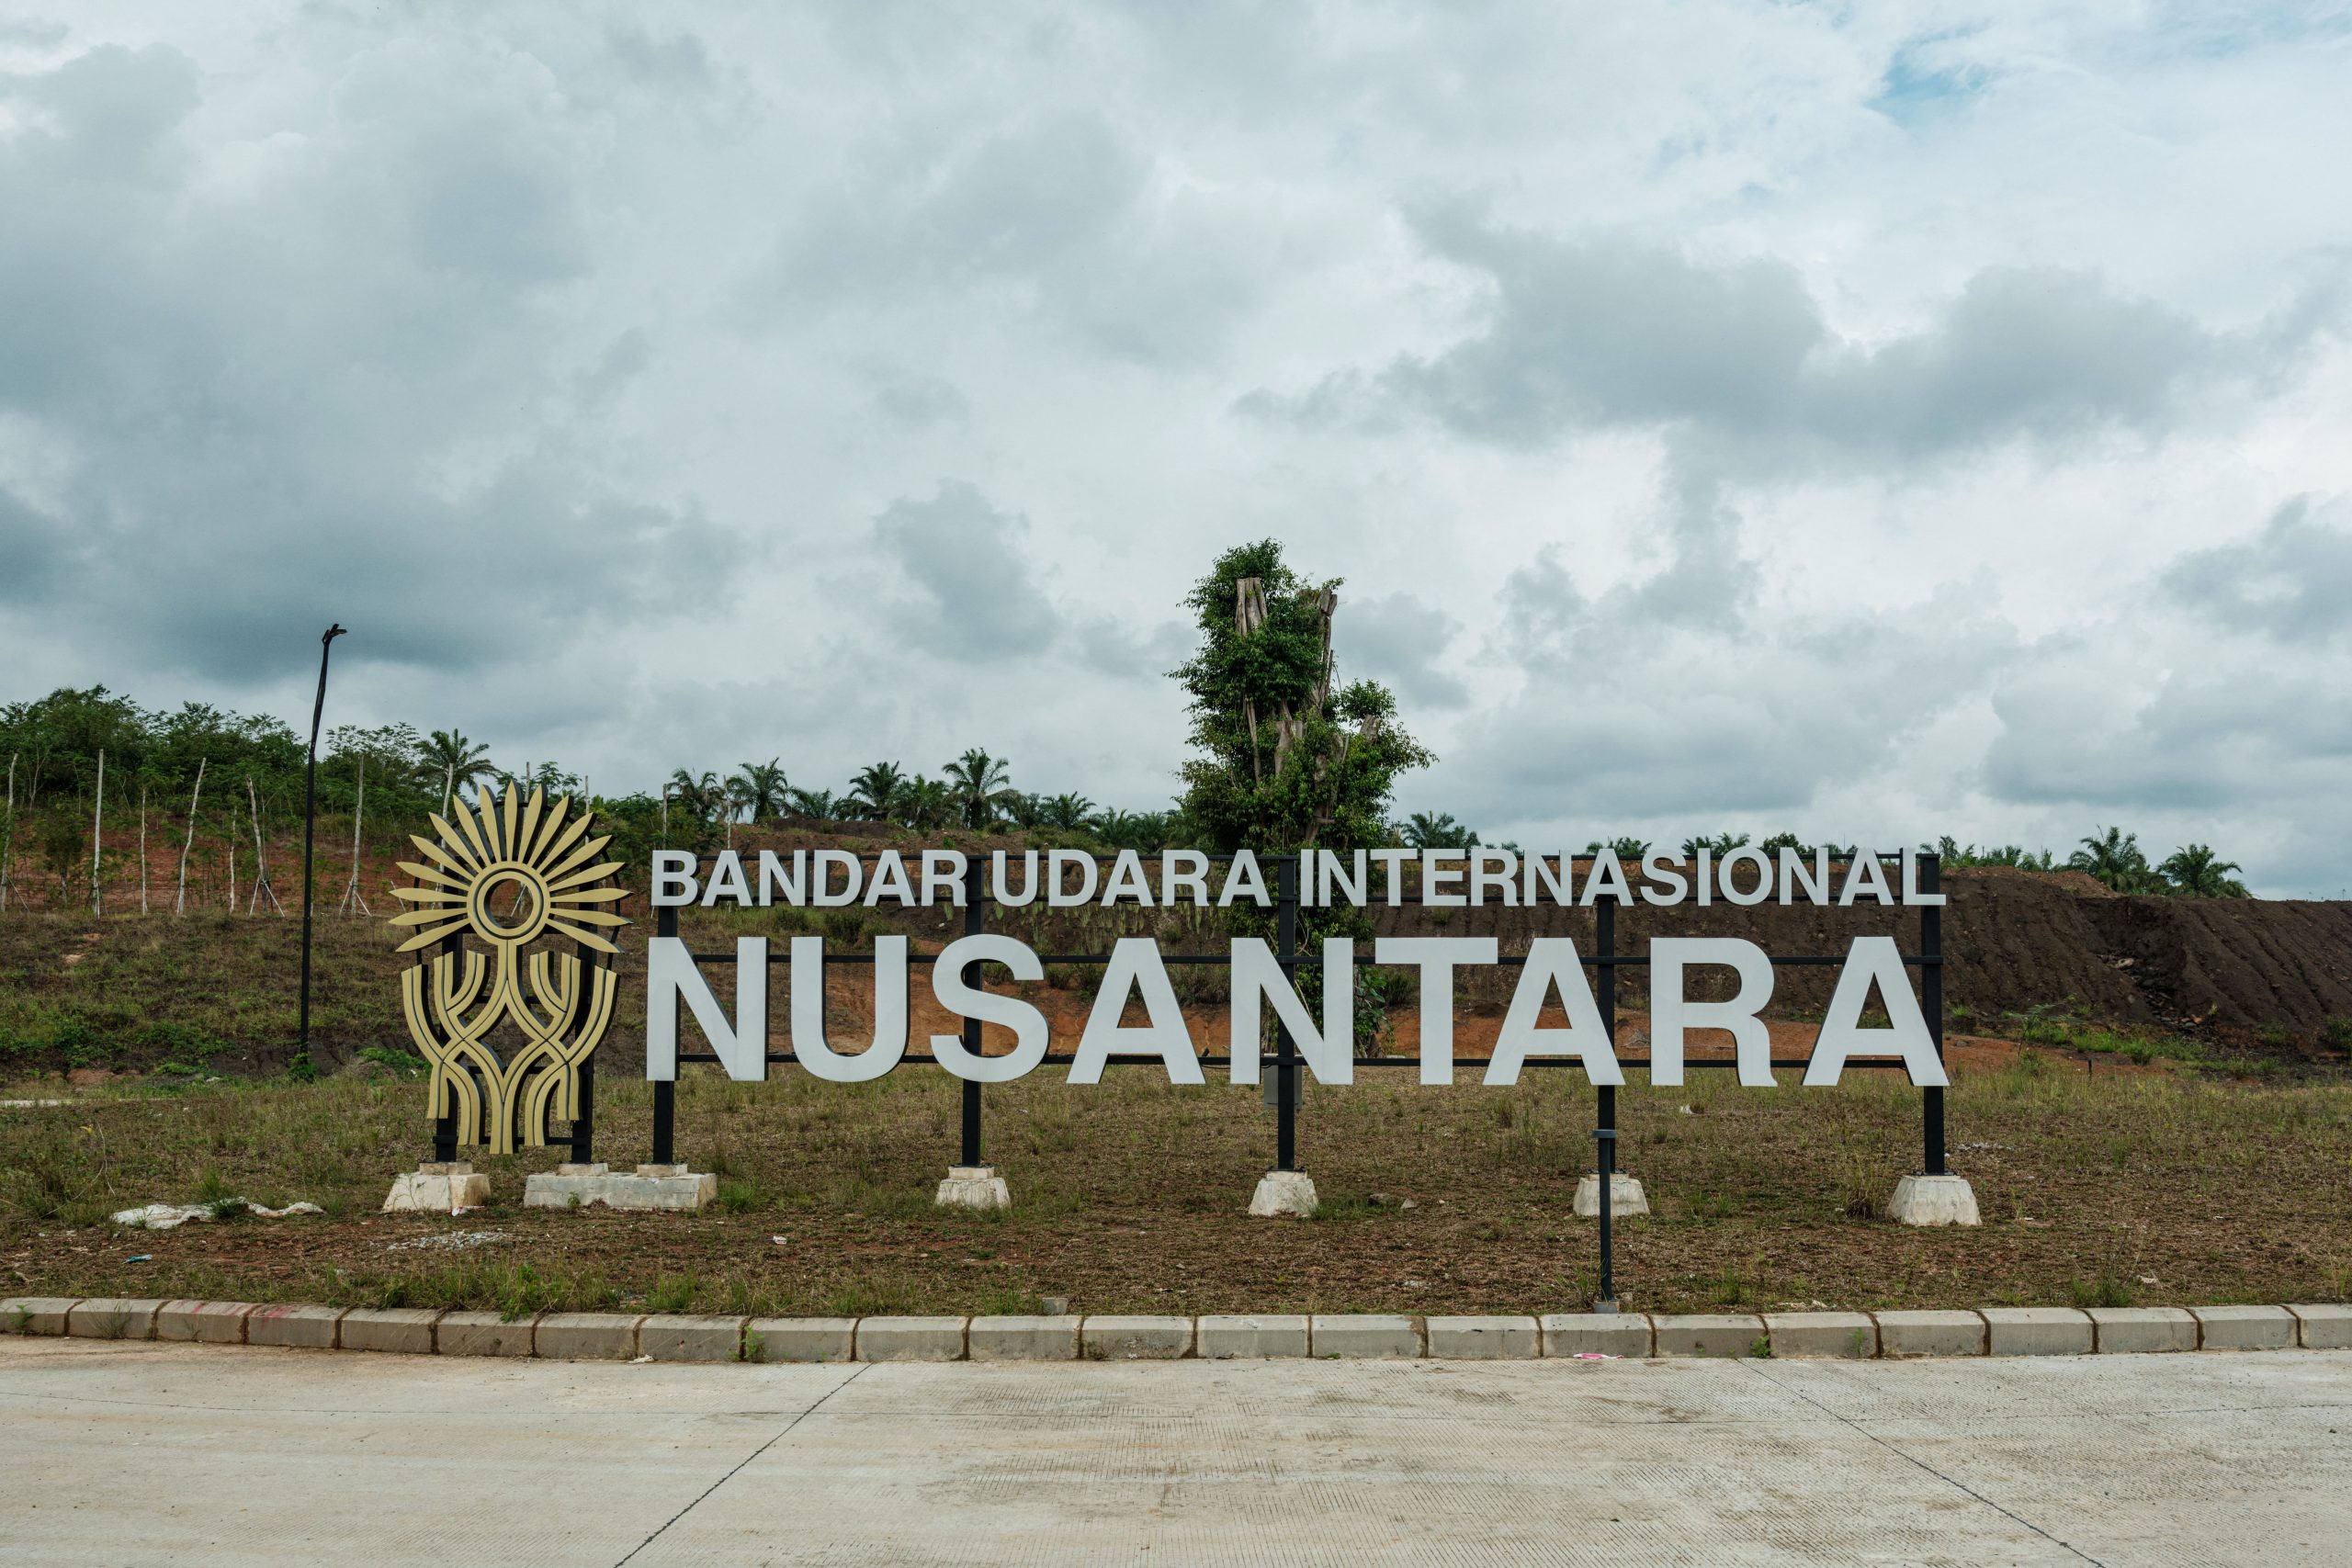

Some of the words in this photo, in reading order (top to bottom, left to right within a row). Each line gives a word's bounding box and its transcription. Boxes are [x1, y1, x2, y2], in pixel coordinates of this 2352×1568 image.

[650, 849, 970, 908] BANDAR
[992, 848, 1272, 908] UDARA
[1298, 847, 1948, 908] INTERNASIONAL
[646, 932, 1951, 1088] NUSANTARA
